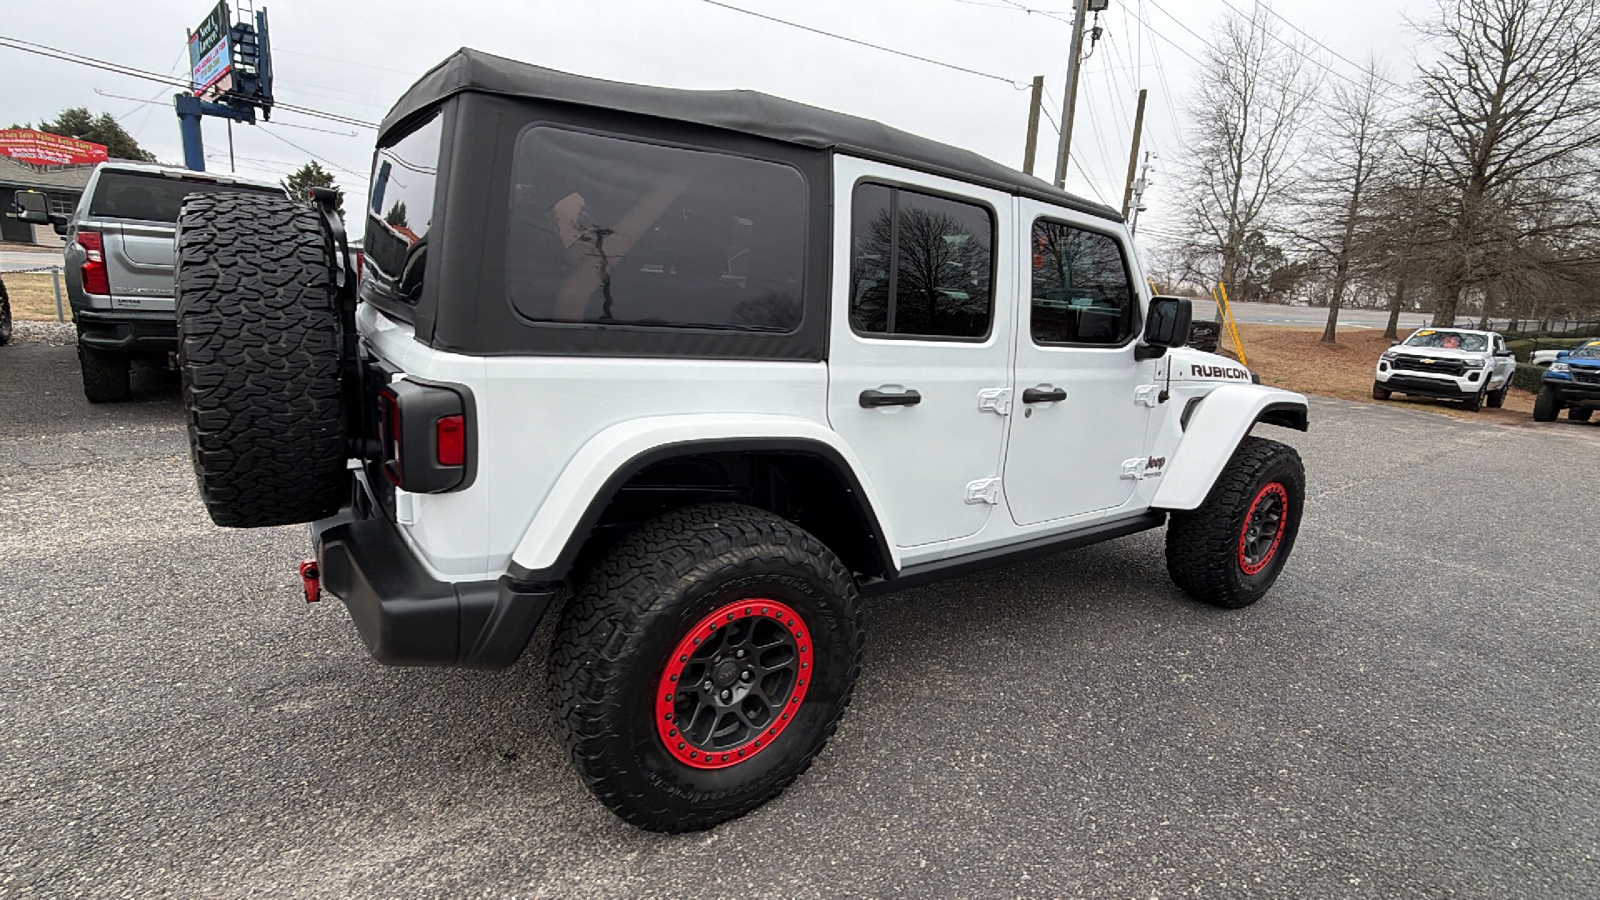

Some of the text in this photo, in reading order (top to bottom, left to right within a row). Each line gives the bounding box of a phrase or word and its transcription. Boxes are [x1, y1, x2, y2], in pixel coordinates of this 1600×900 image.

[58, 137, 73, 146] Auto
[75, 141, 93, 150] Sales
[1191, 364, 1249, 380] RUBICON
[1145, 455, 1166, 471] Jeep
